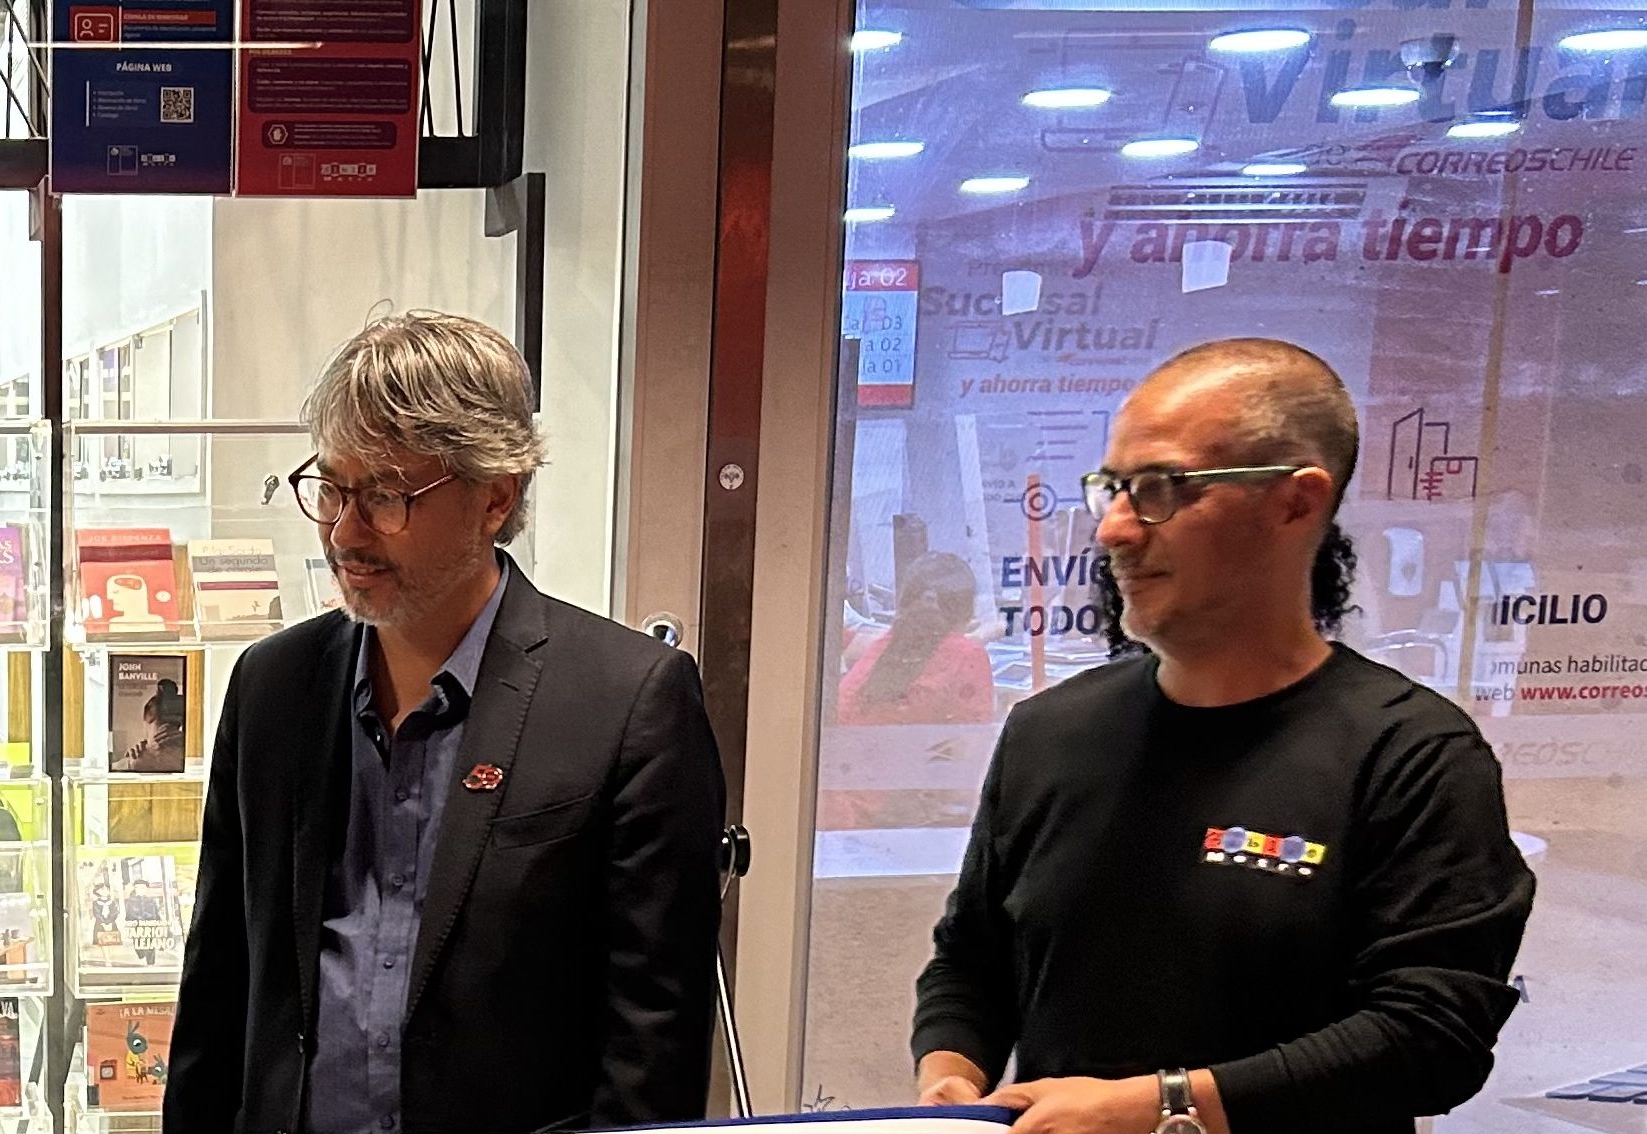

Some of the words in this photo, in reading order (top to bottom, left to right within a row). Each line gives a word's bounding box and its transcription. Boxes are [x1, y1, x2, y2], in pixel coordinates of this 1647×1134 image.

[116, 60, 151, 72] PÁGINA
[152, 62, 173, 72] WEB
[1361, 196, 1585, 275] tiempo
[880, 267, 907, 287] 02
[920, 284, 1103, 317] Sucsal
[1013, 317, 1161, 352] Virtual
[959, 377, 973, 398] y
[979, 374, 1051, 393] ahorra
[200, 557, 216, 567] Un
[219, 557, 270, 569] segundo
[999, 604, 1100, 637] TODO
[118, 662, 142, 671] JOHN
[118, 672, 159, 681] BANVILLE
